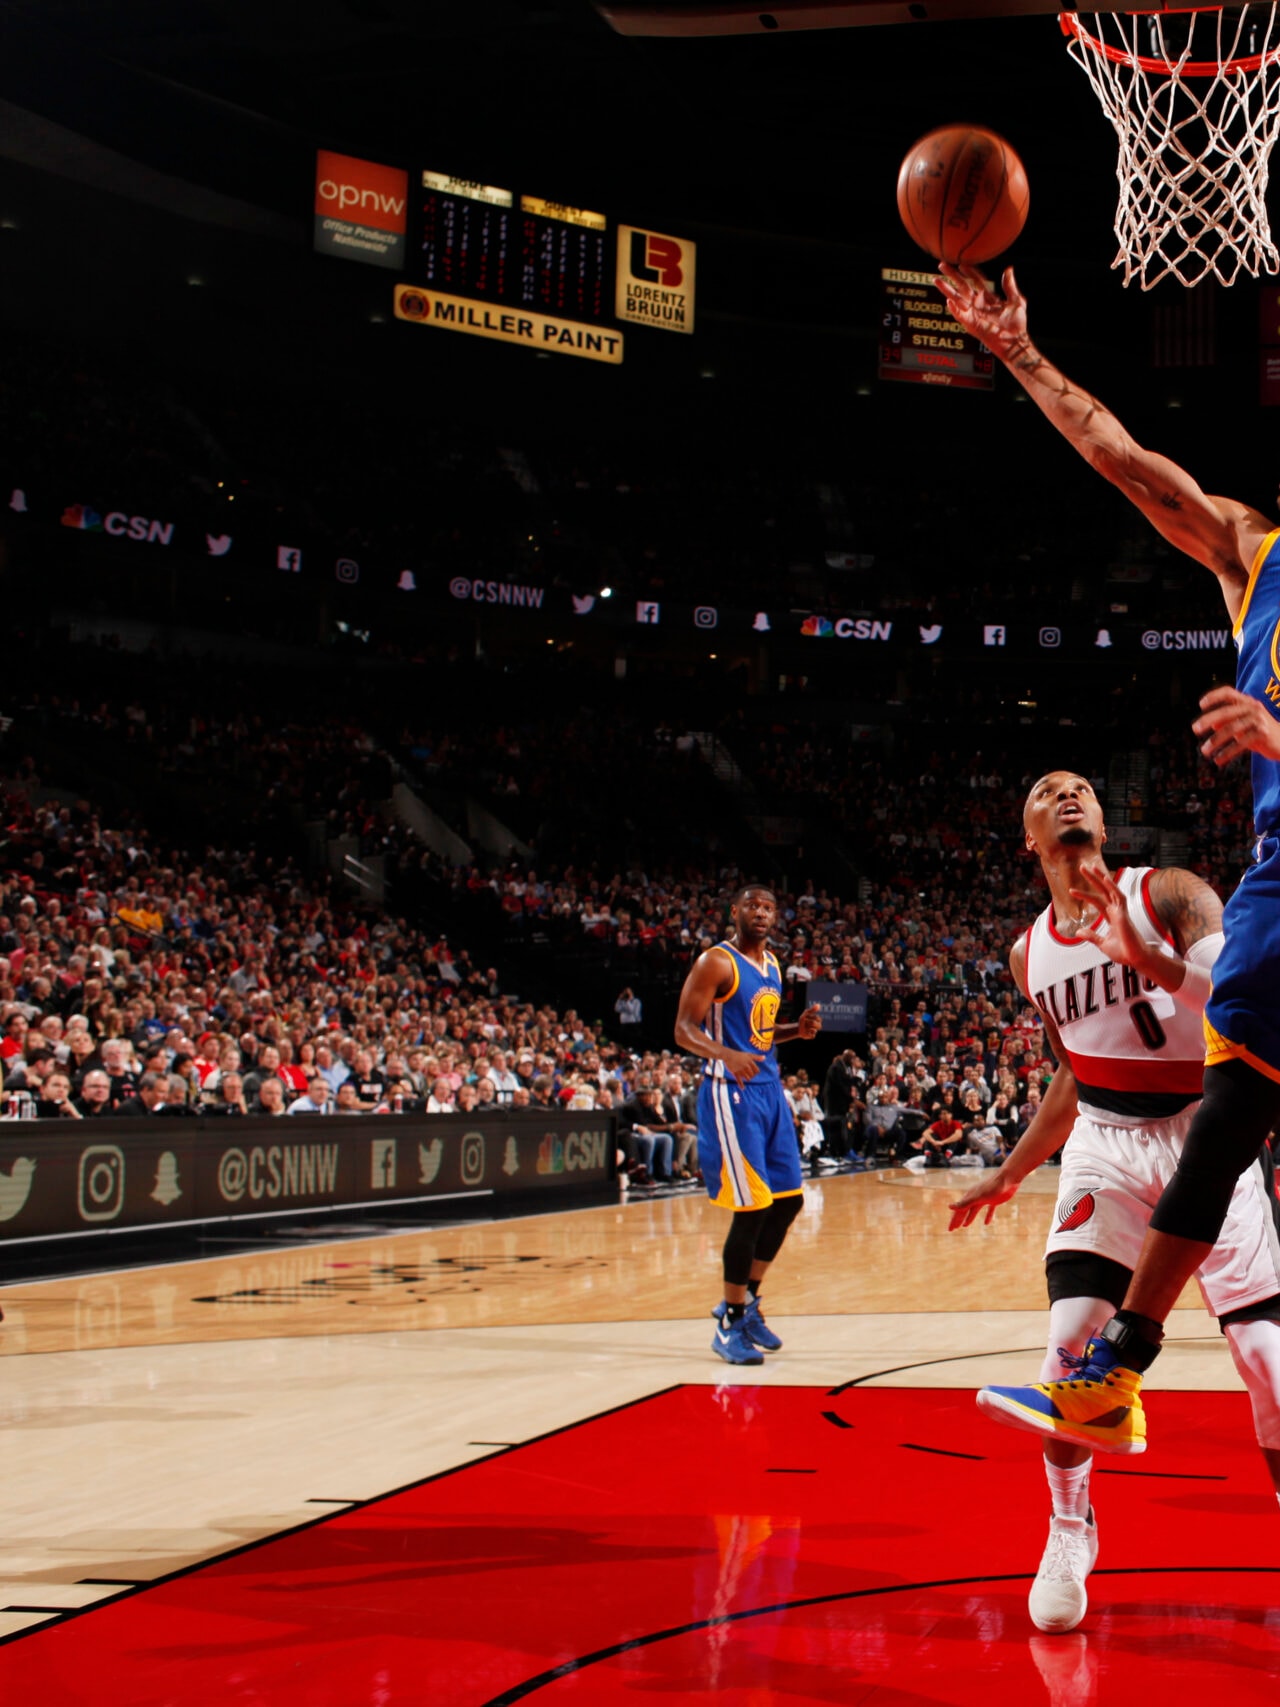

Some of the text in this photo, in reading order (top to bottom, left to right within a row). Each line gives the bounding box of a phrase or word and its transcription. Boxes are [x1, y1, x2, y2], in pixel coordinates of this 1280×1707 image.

[318, 179, 405, 217] opnw
[322, 219, 398, 246] Office Products
[889, 270, 935, 285] HUSTL
[626, 283, 685, 308] LORENTZ
[903, 299, 943, 315] BLOCKED
[626, 298, 685, 323] BRUUN
[434, 301, 619, 355] MILLER PAINT
[907, 316, 967, 334] REBOUNDS
[911, 333, 965, 351] STEALS
[916, 352, 958, 369] TOTAL
[103, 510, 176, 547] CSN
[448, 574, 545, 610] @CSNNW
[834, 616, 894, 641] CSN
[1140, 628, 1230, 652] @CSNNW
[1129, 1000, 1167, 1050] 0
[218, 1143, 340, 1202] @CSNNW
[563, 1130, 608, 1171] CSN
